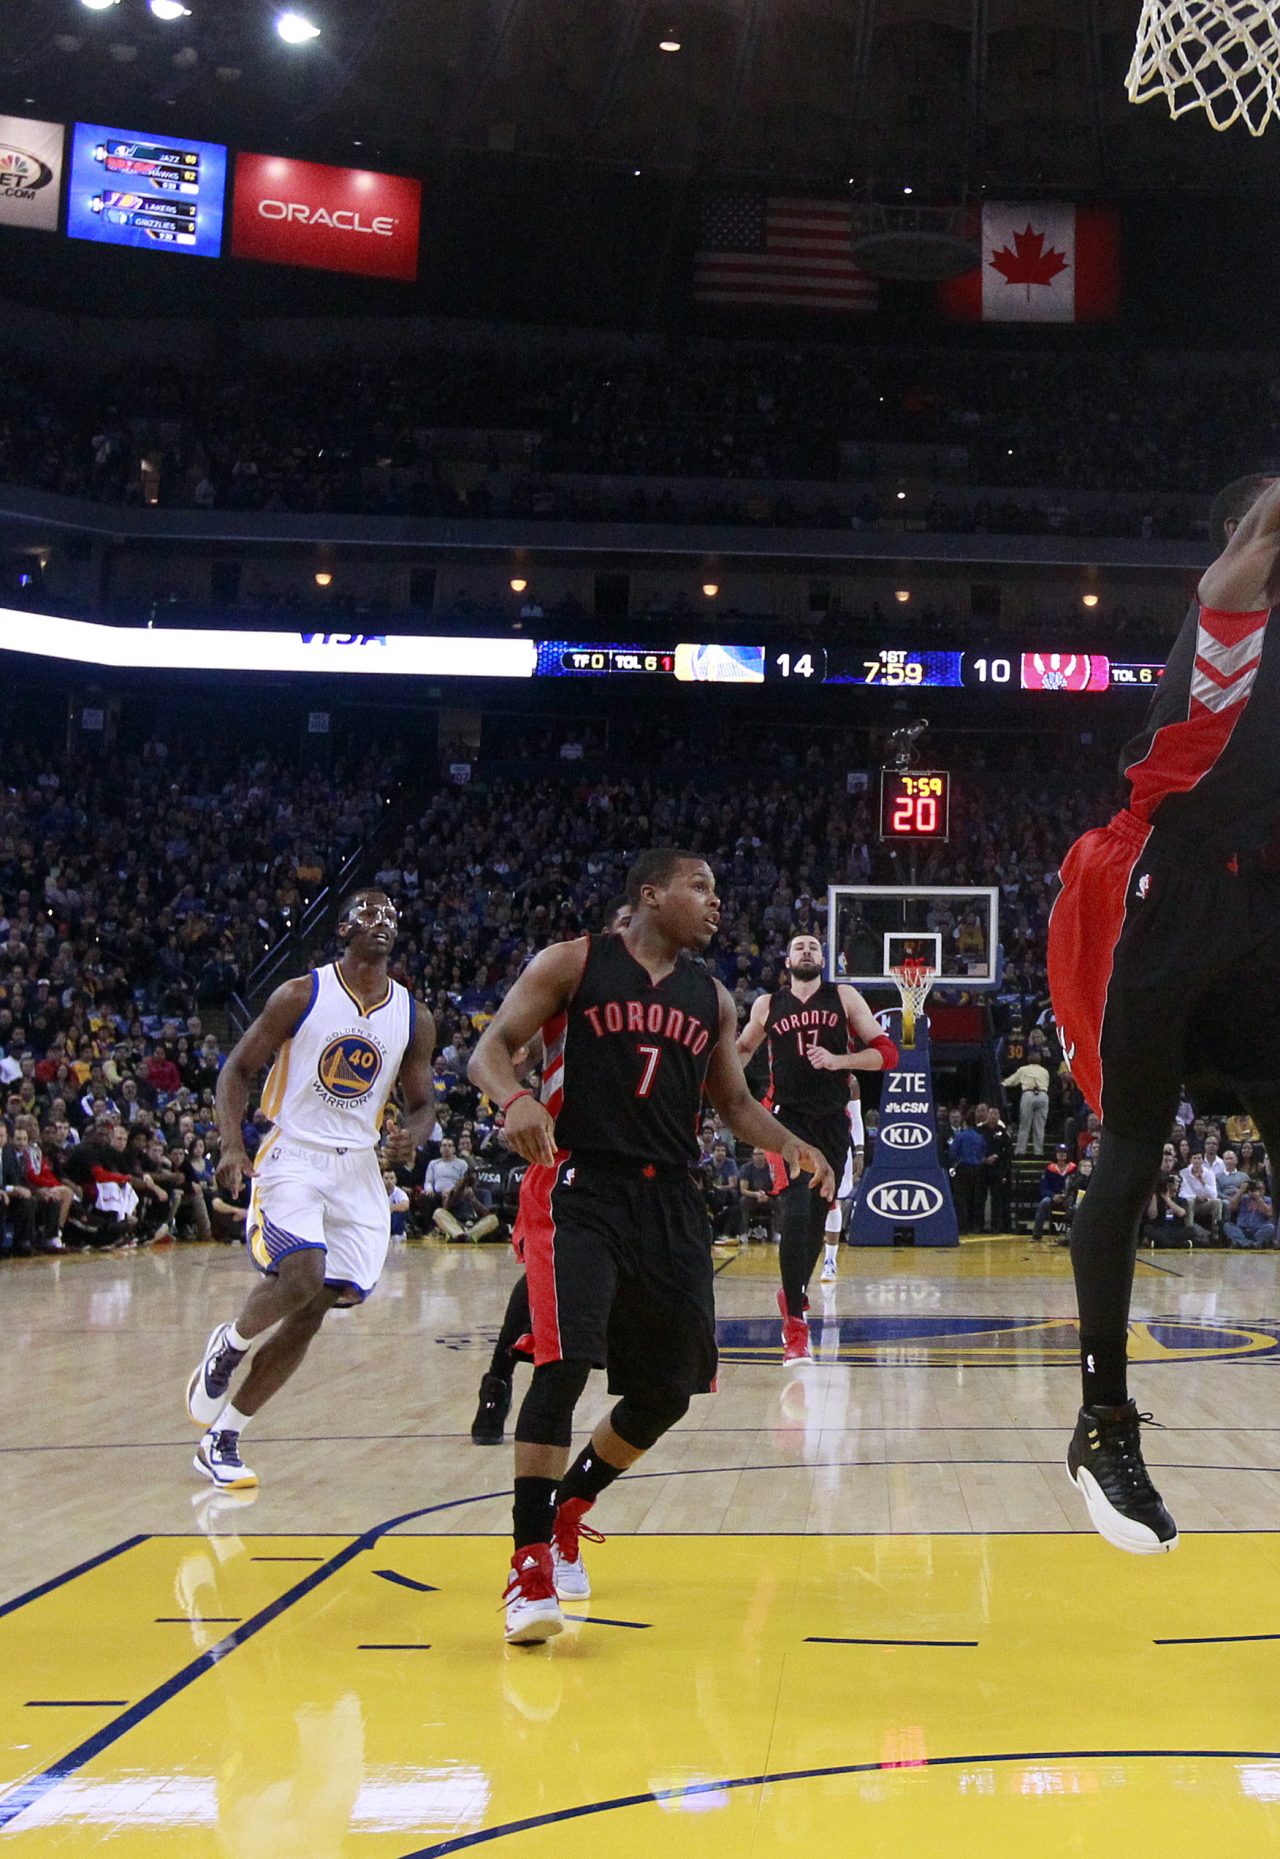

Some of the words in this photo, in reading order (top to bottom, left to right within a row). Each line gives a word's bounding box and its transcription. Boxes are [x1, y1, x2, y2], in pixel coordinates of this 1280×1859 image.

[145, 203, 177, 214] LAKERS
[257, 199, 395, 237] ORACLE
[135, 218, 176, 231] GRIZZLIES
[572, 655, 589, 668] TF
[591, 653, 604, 669] 0
[615, 655, 642, 670] TOL
[644, 656, 657, 671] 6
[776, 654, 815, 677] 14
[879, 650, 908, 663] 1ST
[863, 662, 924, 684] 7:59
[973, 659, 1011, 683] 10
[1112, 669, 1137, 682] TOL
[1139, 668, 1152, 682] 6
[902, 777, 942, 797] 7:59
[893, 797, 936, 831] 20
[584, 1000, 710, 1057] TORONTO
[772, 1009, 839, 1036] TORONTO
[325, 1027, 364, 1043] GOLDEN
[367, 1032, 389, 1056] STATE
[797, 1029, 820, 1057] 17
[1007, 1044, 1024, 1059] 30
[348, 1050, 375, 1069] 40
[636, 1044, 661, 1098] 7
[888, 1072, 927, 1093] ZTE
[311, 1079, 374, 1109] WARRIORS
[901, 1102, 930, 1114] CSN
[889, 1128, 924, 1144] KIA
[478, 1171, 501, 1184] VISA
[880, 1189, 932, 1211] KIA
[1053, 1221, 1072, 1233] VI
